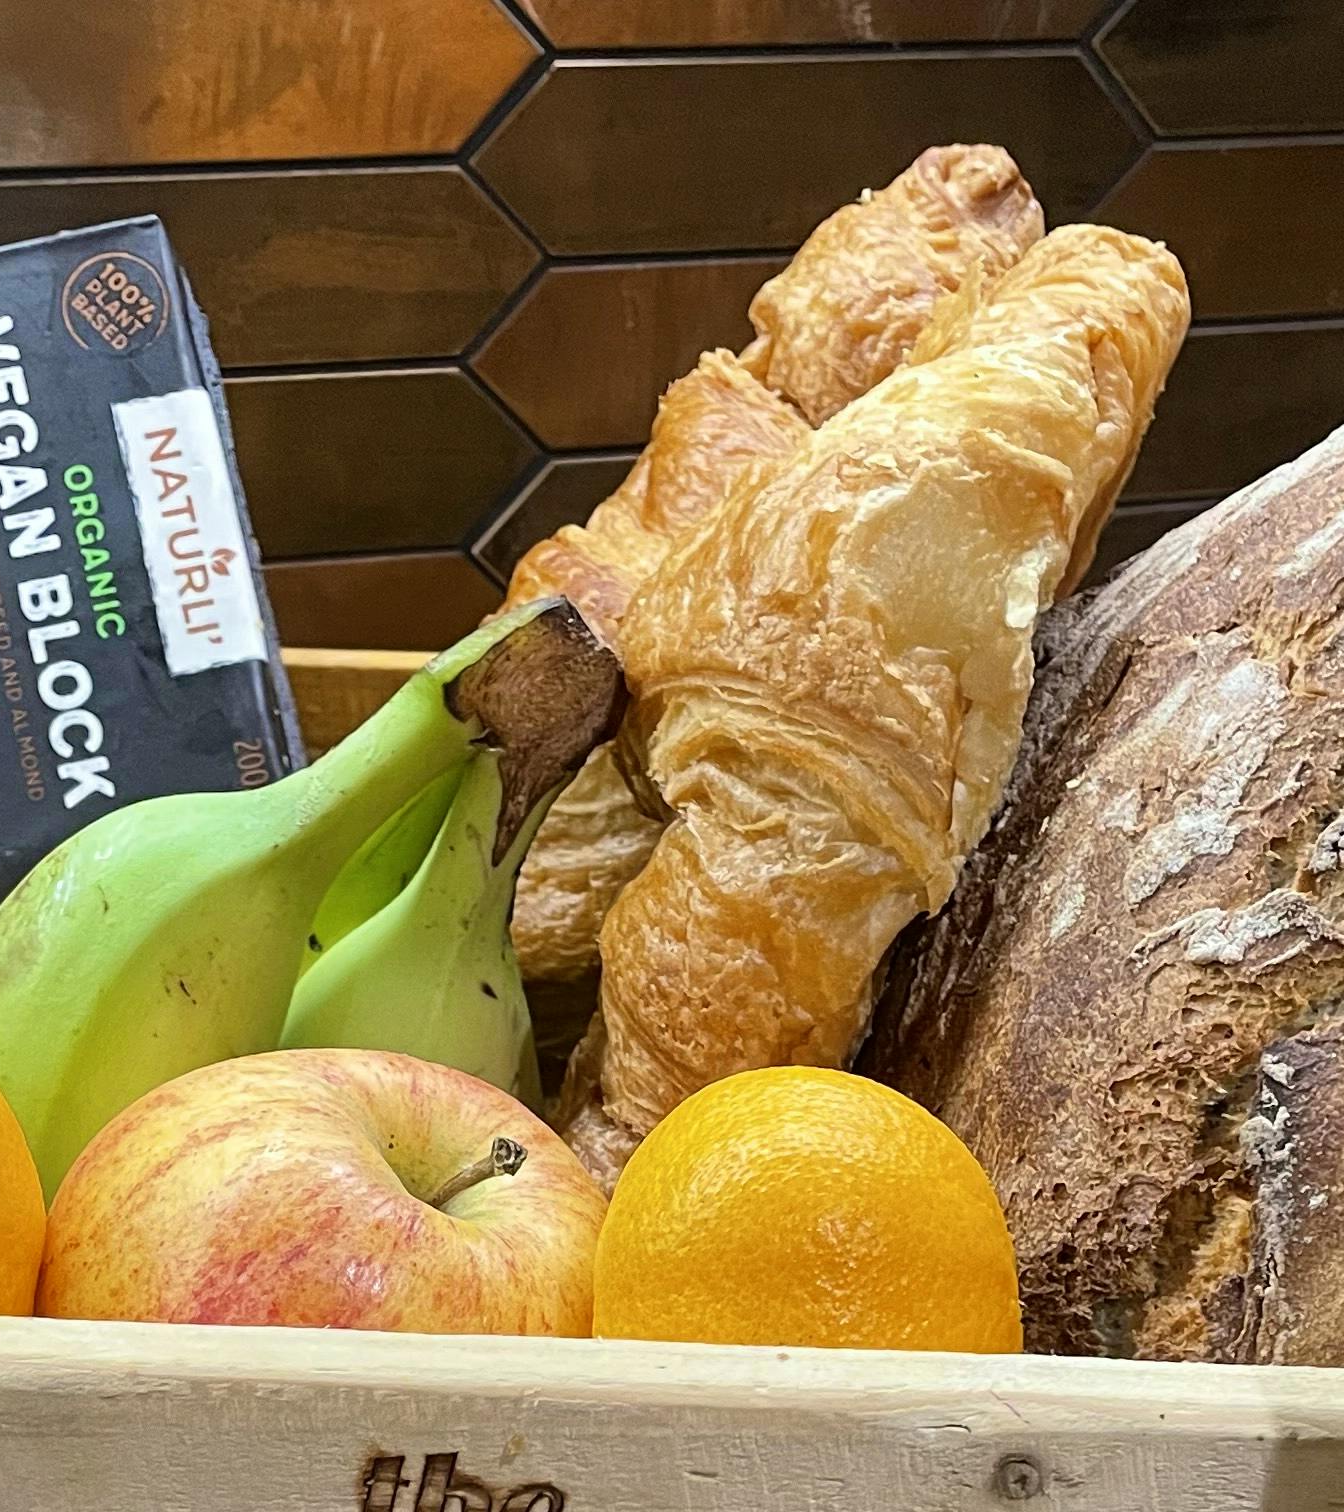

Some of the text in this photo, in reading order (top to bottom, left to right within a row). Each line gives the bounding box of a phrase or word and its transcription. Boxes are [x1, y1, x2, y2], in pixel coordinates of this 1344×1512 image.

[71, 292, 128, 350] BASED
[85, 278, 145, 335] PLANT
[99, 262, 156, 323] 100%
[63, 463, 127, 640] ORGANIC
[0, 657, 23, 701] AND
[12, 708, 45, 802] ALMOND
[17, 573, 116, 809] BLOCK
